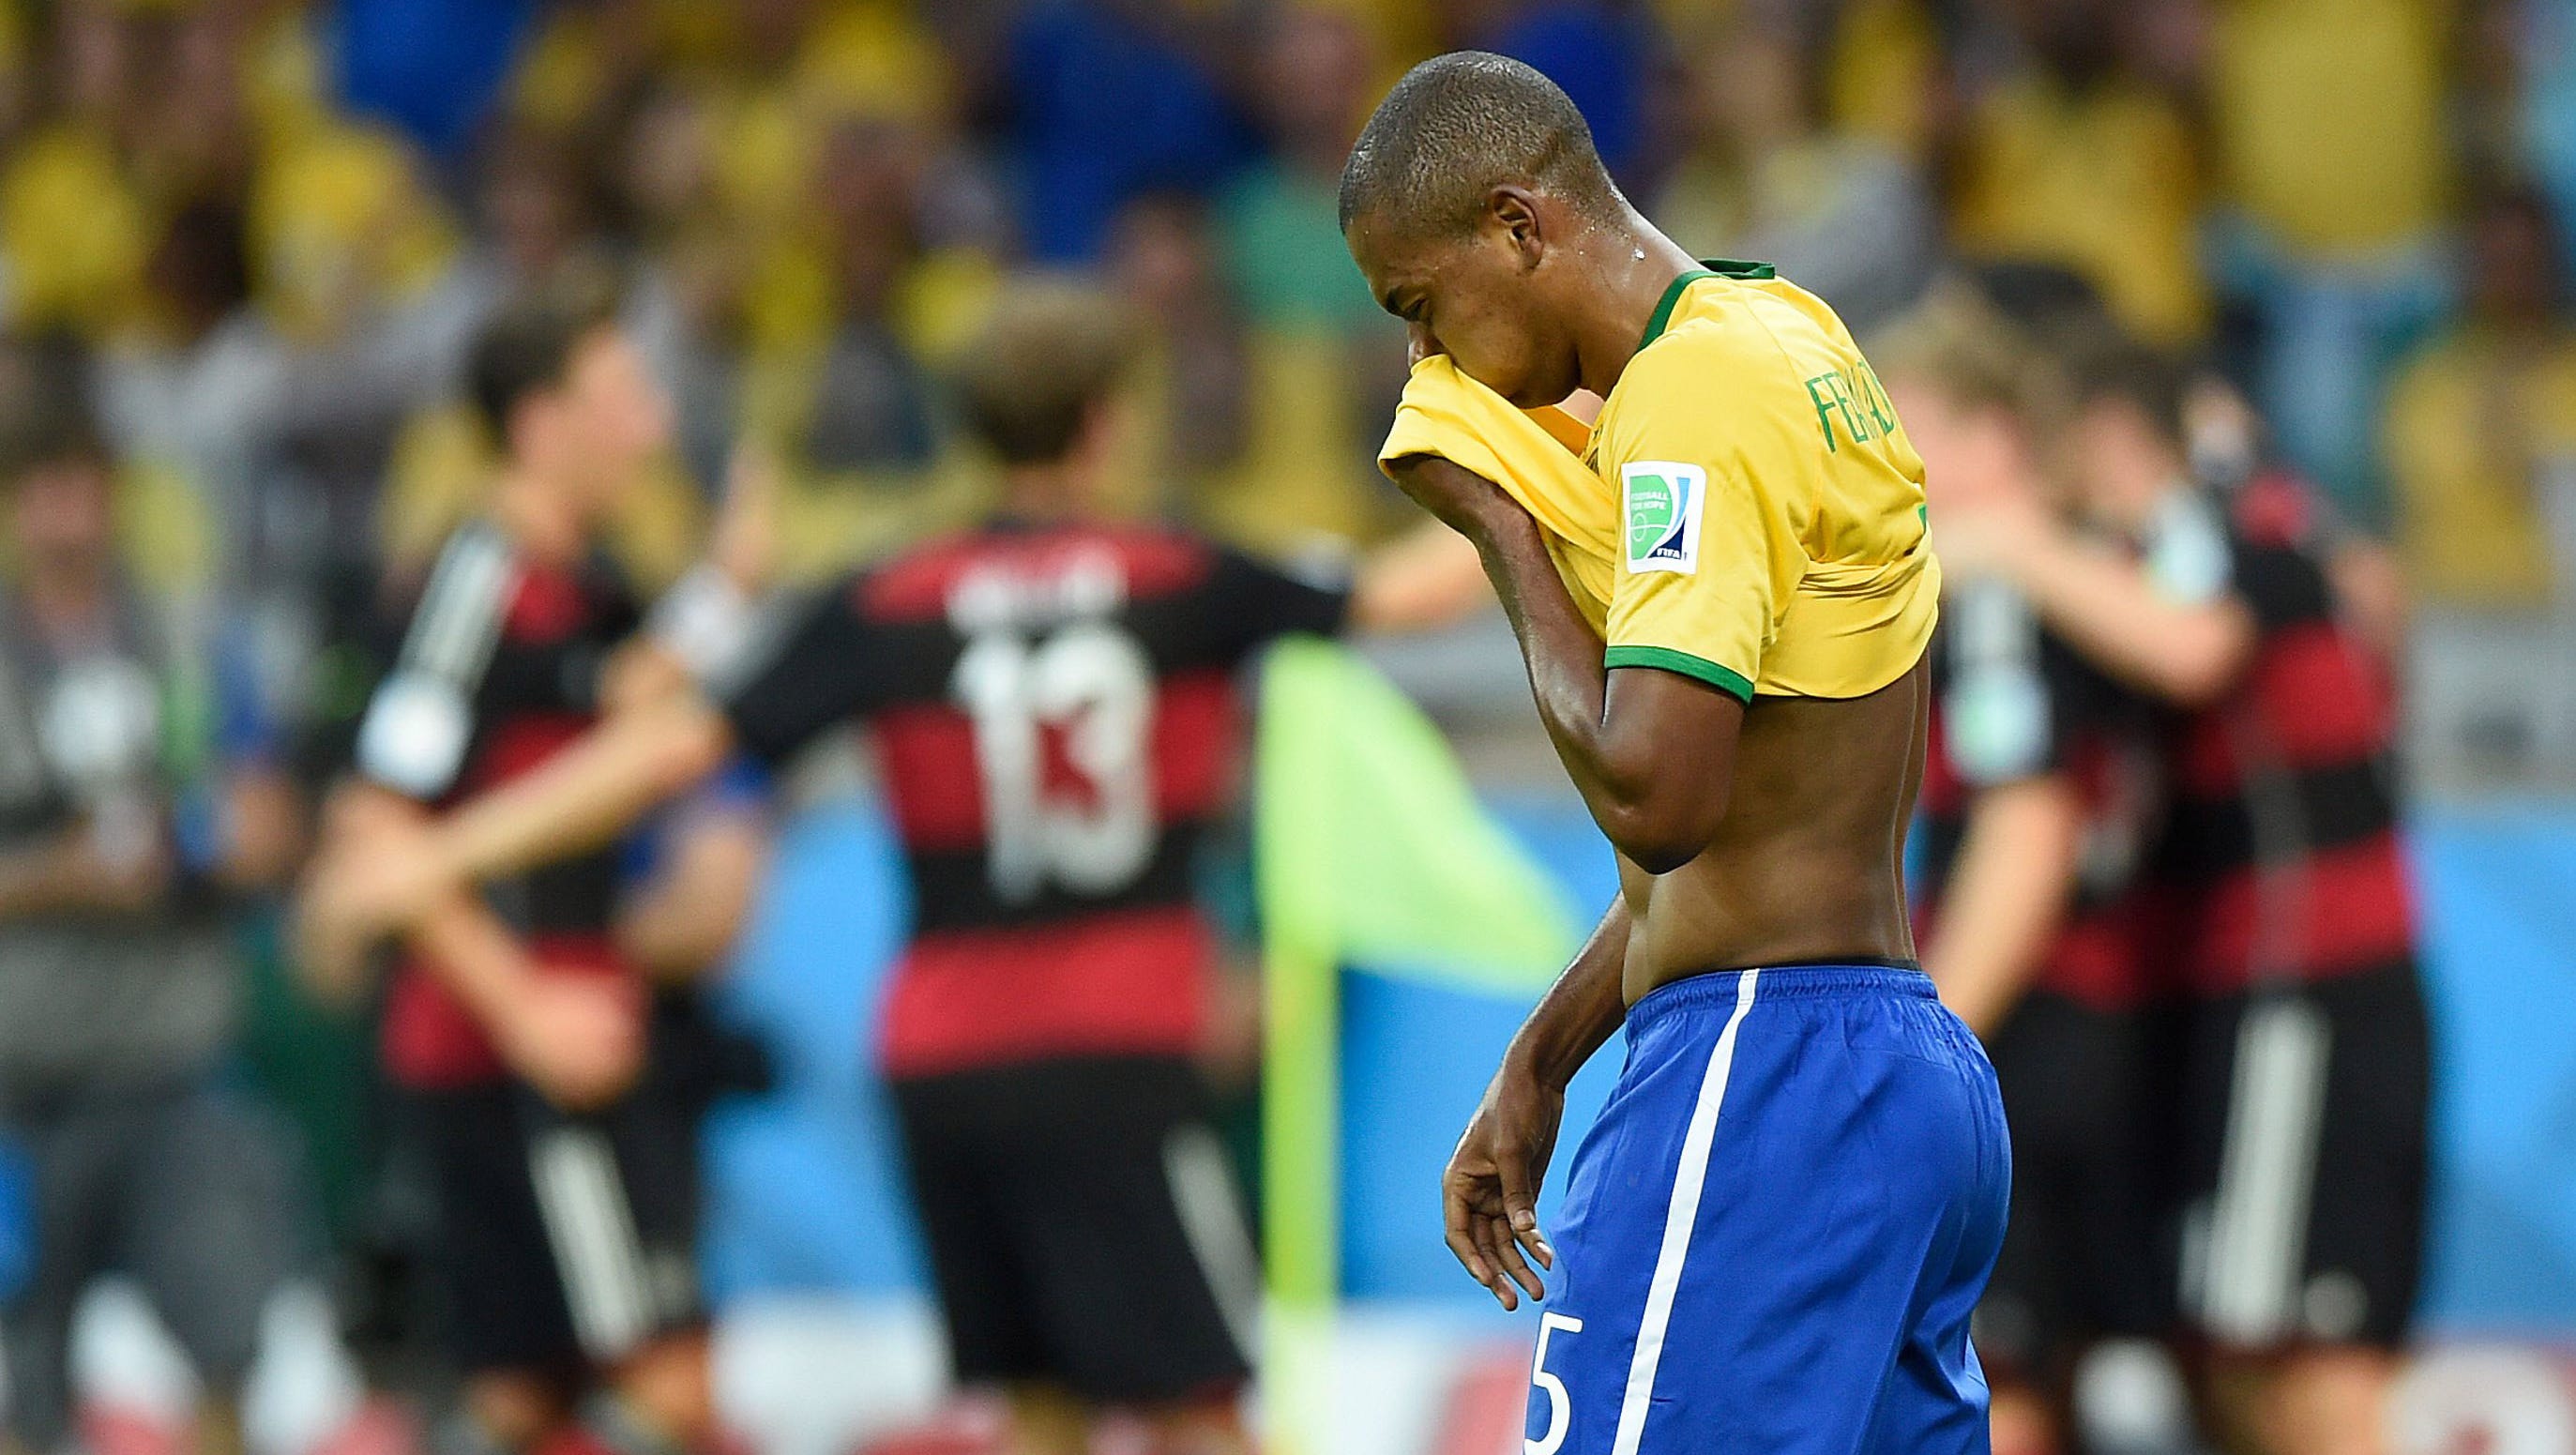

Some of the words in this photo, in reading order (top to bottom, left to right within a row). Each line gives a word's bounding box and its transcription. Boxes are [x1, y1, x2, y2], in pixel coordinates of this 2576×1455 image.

[1657, 548, 1680, 558] FIFA
[951, 623, 1161, 902] 13
[1524, 1311, 1583, 1455] 5
